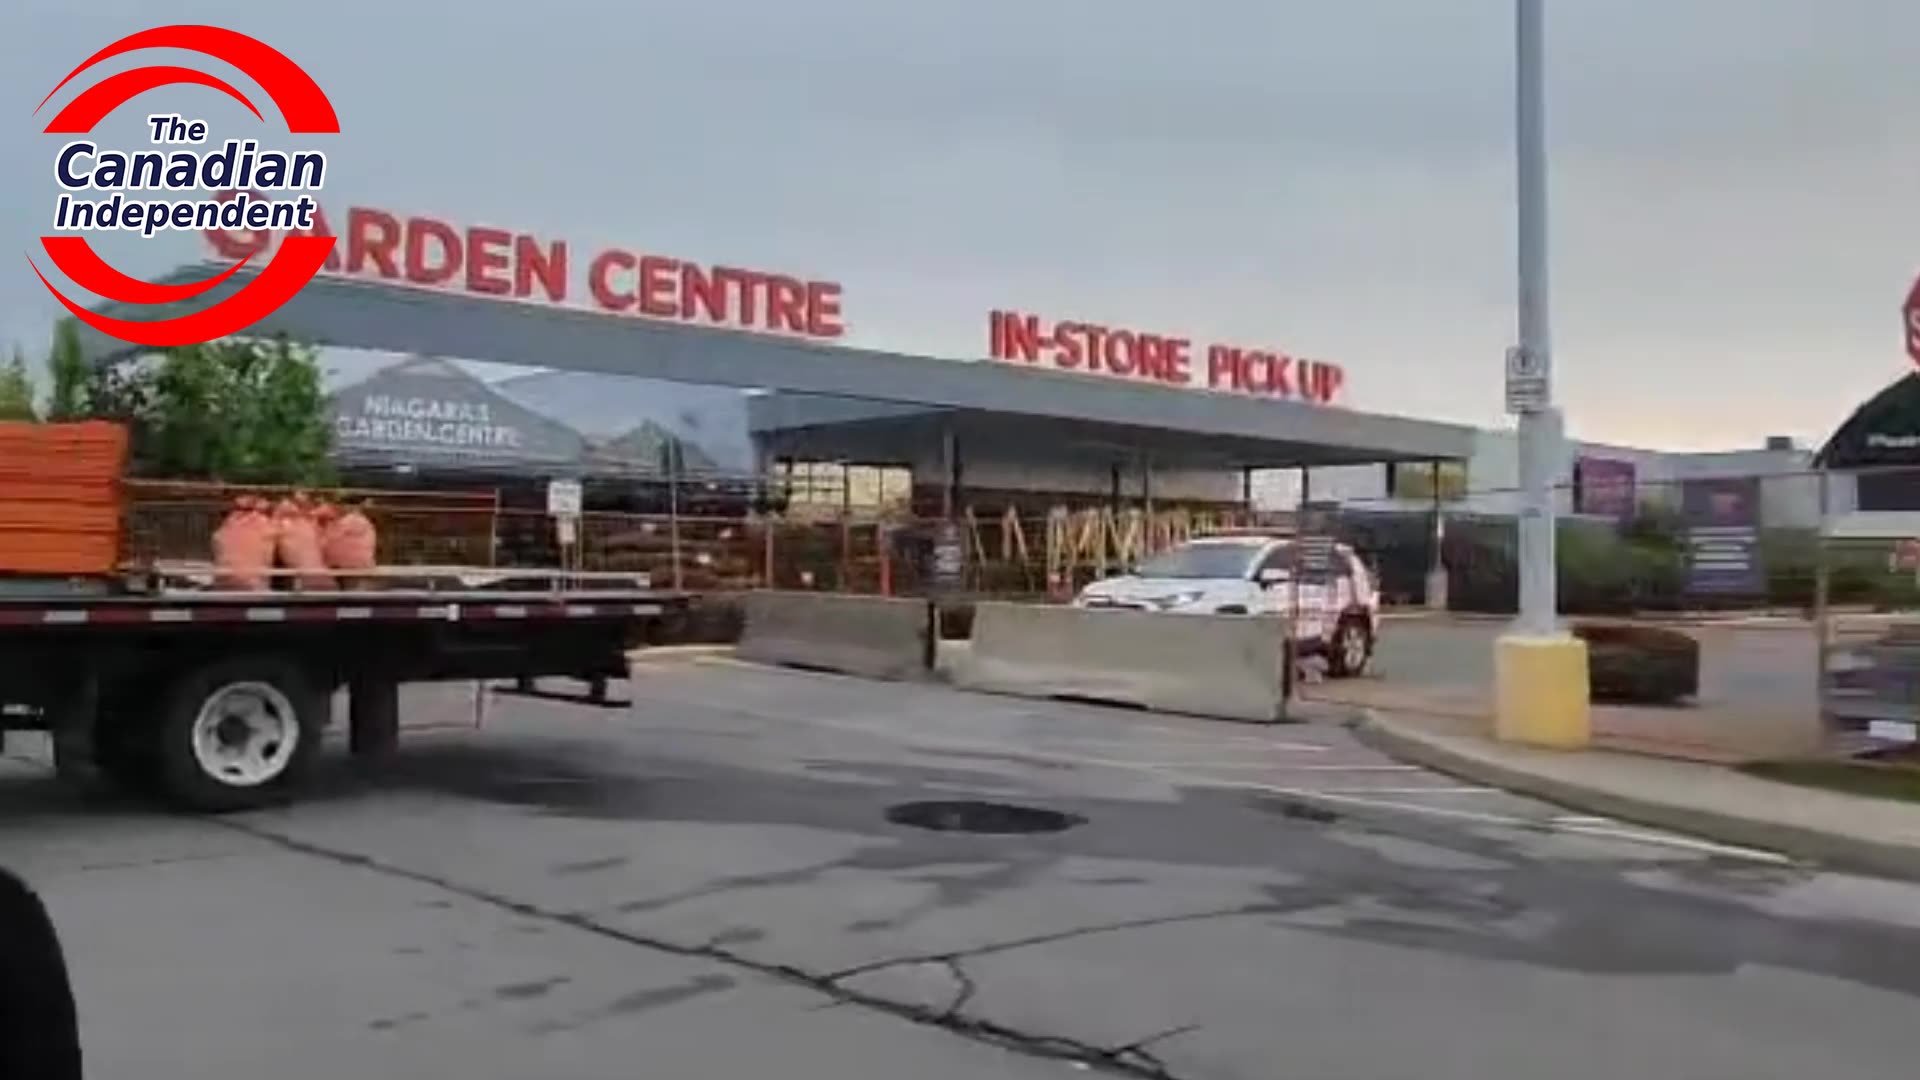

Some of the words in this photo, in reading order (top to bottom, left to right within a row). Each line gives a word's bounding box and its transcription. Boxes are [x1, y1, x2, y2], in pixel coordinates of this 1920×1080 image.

[589, 250, 844, 337] CENTRE
[989, 310, 1191, 383] IN-STORE
[1207, 345, 1291, 396] PICK
[1300, 359, 1343, 402] UP
